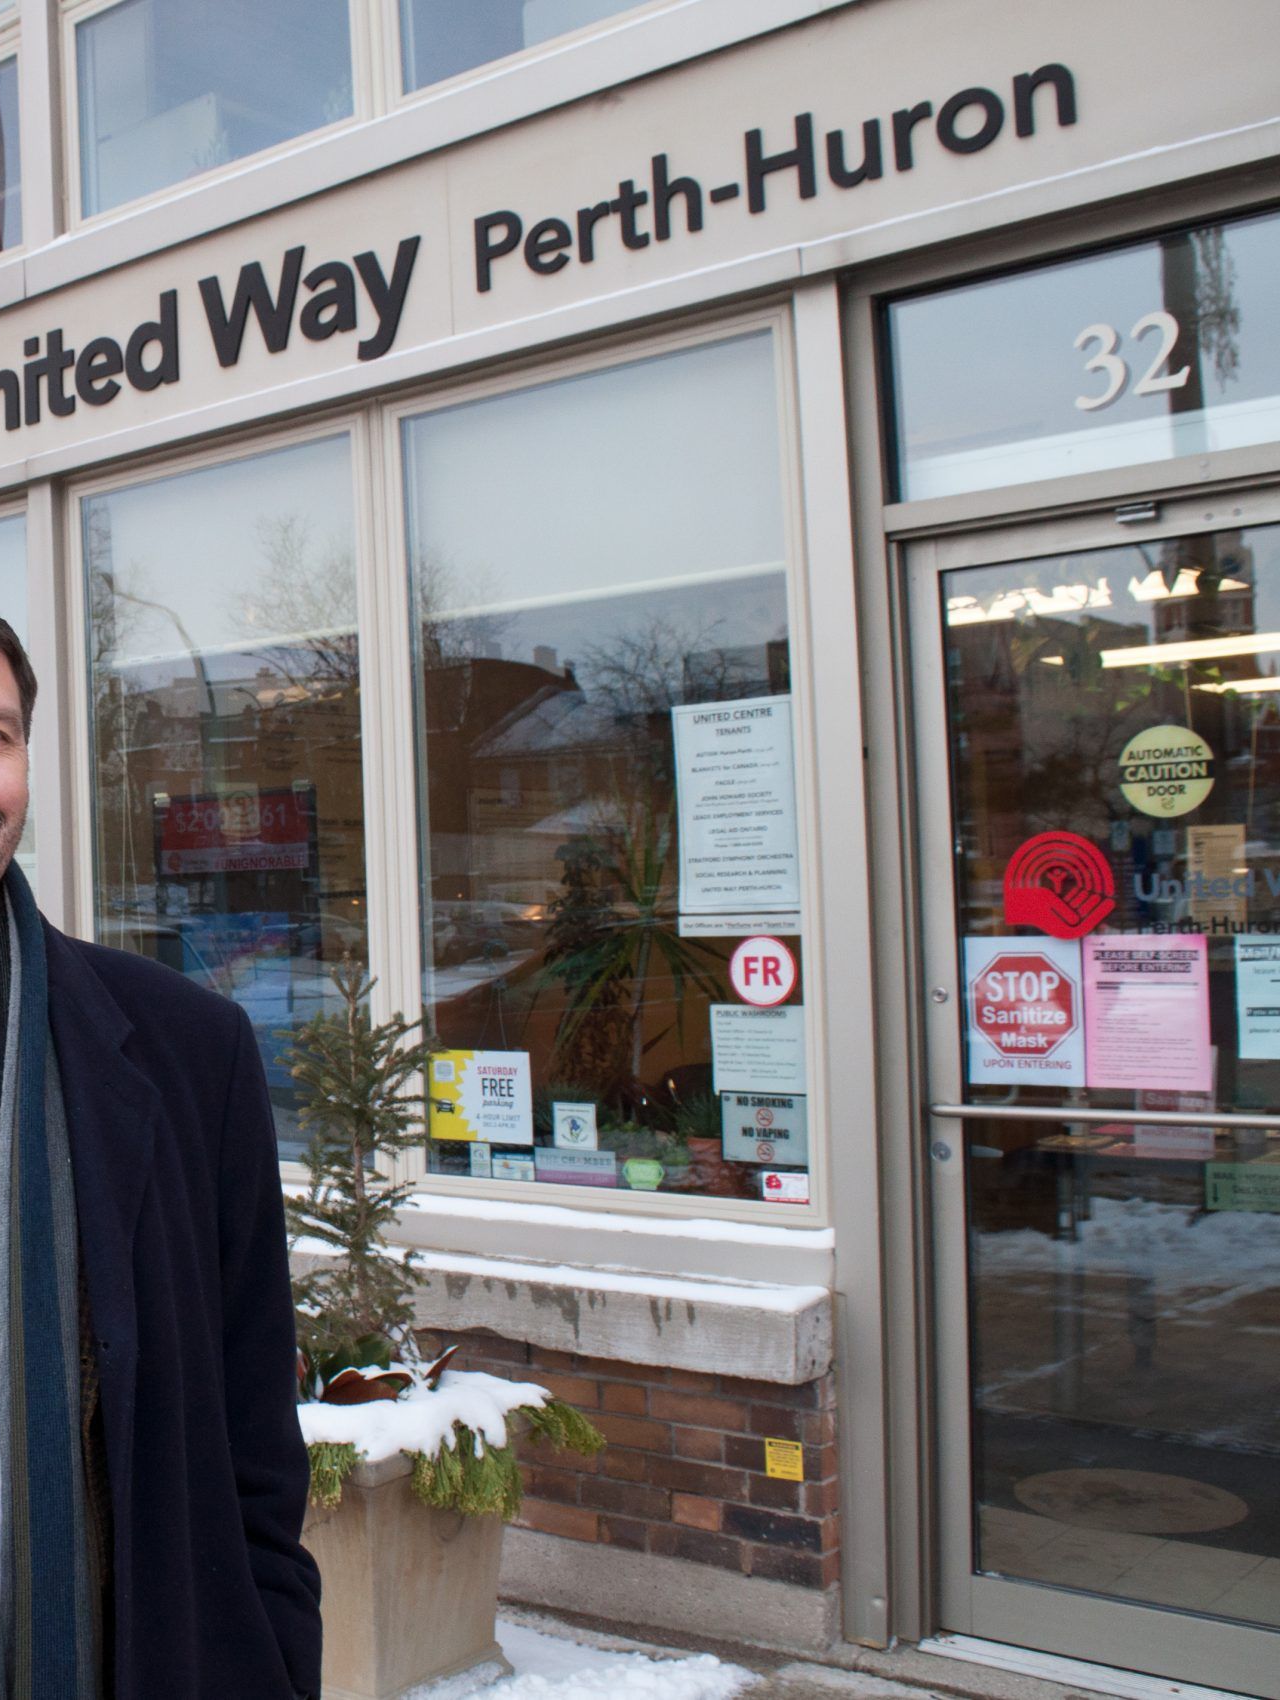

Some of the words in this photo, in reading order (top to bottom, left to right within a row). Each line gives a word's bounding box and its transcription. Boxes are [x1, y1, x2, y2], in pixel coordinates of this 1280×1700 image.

[198, 235, 422, 368] Way
[474, 62, 1077, 293] Perth-Huron
[1073, 310, 1191, 411] 32
[692, 711, 731, 725] UNITED
[732, 707, 773, 721] CENTRE
[715, 725, 752, 736] TENANTS
[1126, 744, 1204, 761] AUTOMATIC
[1124, 761, 1208, 782] CAUTION
[1146, 784, 1187, 797] DOOR
[1133, 868, 1256, 901] United
[1093, 951, 1131, 960] PLEASE
[742, 956, 783, 986] FR
[1103, 962, 1140, 972] BEFORE
[1141, 962, 1192, 972] ENTERING
[984, 970, 1060, 1003] STOP
[716, 1010, 739, 1018] PUBLIC
[741, 1010, 787, 1019] WASHROOMS
[982, 1004, 1067, 1025] Sanitize
[1001, 1031, 1048, 1048] Mask
[477, 1065, 518, 1077] SATURDAY
[983, 1058, 1015, 1069] UPON
[1017, 1059, 1073, 1071] ENTERING
[481, 1078, 515, 1098] FREE
[482, 1098, 515, 1110] parking
[736, 1095, 749, 1106] NO
[750, 1096, 794, 1109] SMOKING
[741, 1126, 755, 1137] NO
[756, 1127, 790, 1140] VAPING
